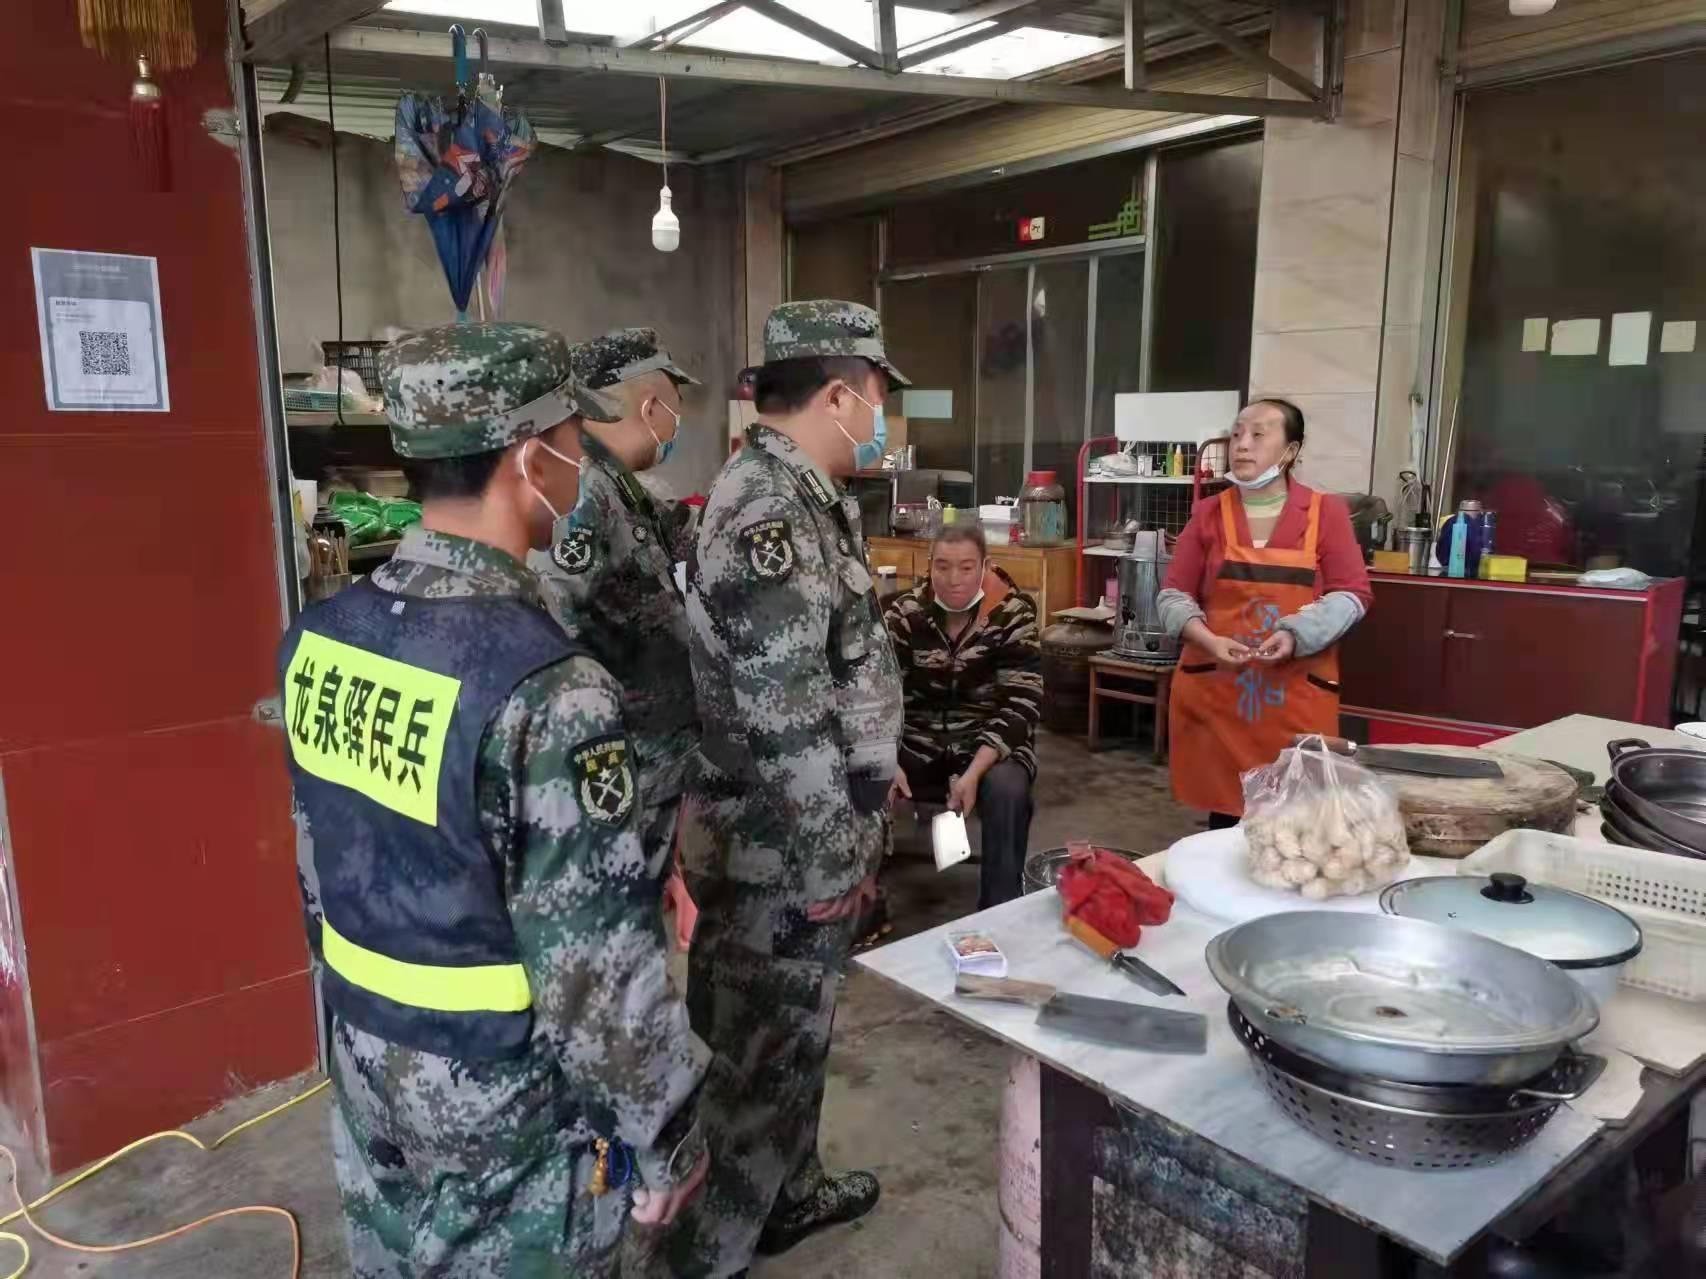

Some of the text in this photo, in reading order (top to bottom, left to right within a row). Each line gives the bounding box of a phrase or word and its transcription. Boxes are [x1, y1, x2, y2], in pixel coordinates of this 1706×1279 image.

[292, 656, 434, 794] 龙泉驿民兵
